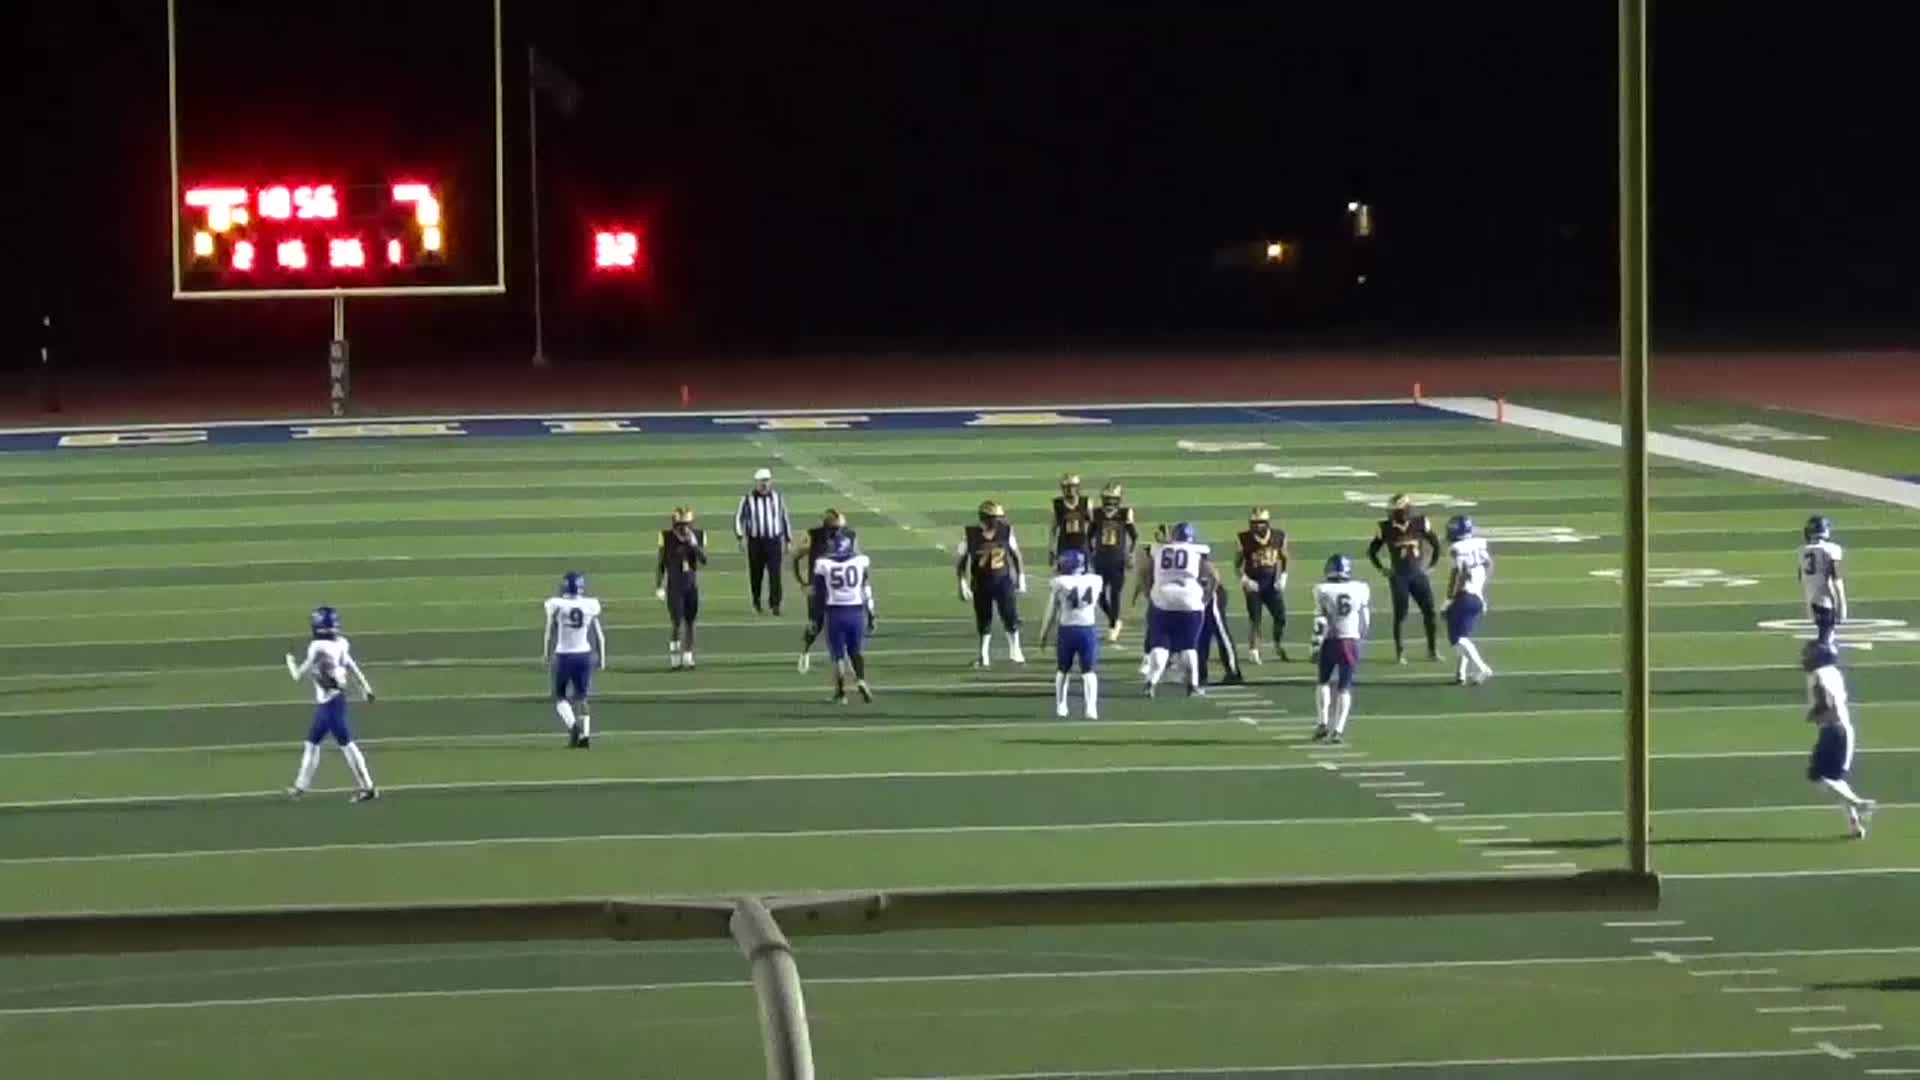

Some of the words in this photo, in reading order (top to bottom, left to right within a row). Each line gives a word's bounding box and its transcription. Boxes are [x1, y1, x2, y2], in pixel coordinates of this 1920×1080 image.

[1160, 547, 1188, 570] 60
[1804, 552, 1816, 576] 3
[829, 565, 859, 590] 50
[1067, 586, 1095, 609] 44
[1336, 593, 1351, 617] 6
